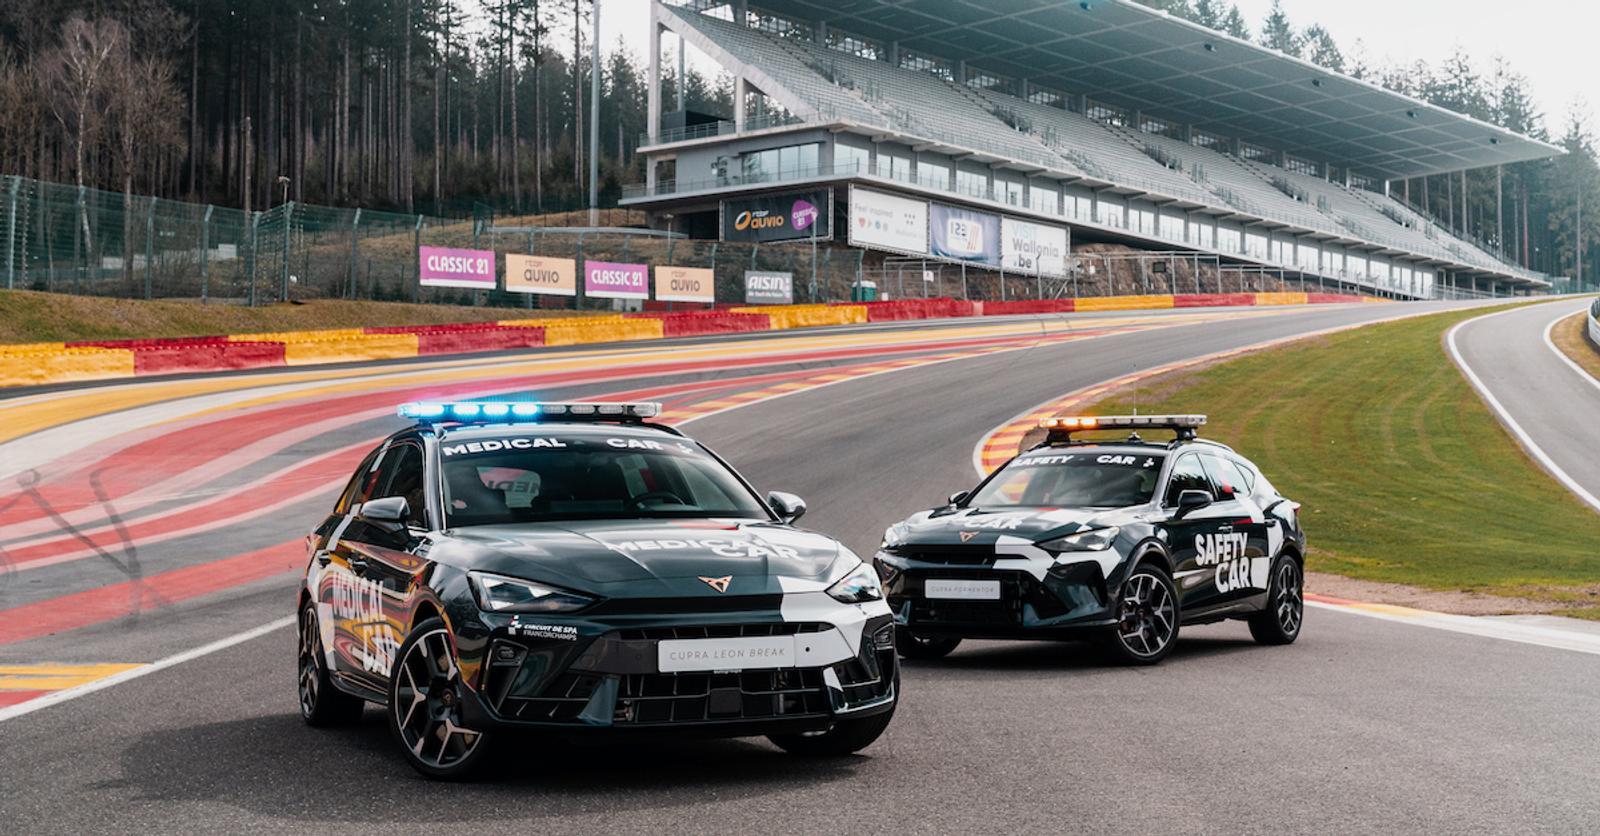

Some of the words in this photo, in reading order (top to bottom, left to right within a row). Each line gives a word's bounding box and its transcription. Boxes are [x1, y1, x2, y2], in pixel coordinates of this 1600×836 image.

[751, 215, 784, 229] auvio
[1012, 238, 1059, 257] Wallonia
[428, 255, 474, 274] CLASSIC
[476, 258, 489, 275] 21
[523, 269, 559, 283] auvio
[591, 269, 630, 286] CLASSIC
[632, 272, 643, 287] 21
[748, 276, 784, 290] AISIN
[670, 279, 700, 291] auvio
[442, 438, 567, 457] MEDICAL
[606, 438, 664, 450] CAR
[1009, 455, 1074, 467] SAFETY
[1096, 455, 1136, 465] CAR
[605, 533, 768, 551] MEDICAL
[1195, 532, 1248, 566] SAFETY
[711, 544, 800, 560] CAR
[1215, 557, 1251, 593] CAR
[333, 573, 386, 623] MEDICAL
[552, 625, 563, 633] DE
[563, 626, 577, 634] SPA
[670, 651, 709, 660] CUPRA
[713, 649, 745, 659] LEON
[749, 647, 785, 657] BREAK
